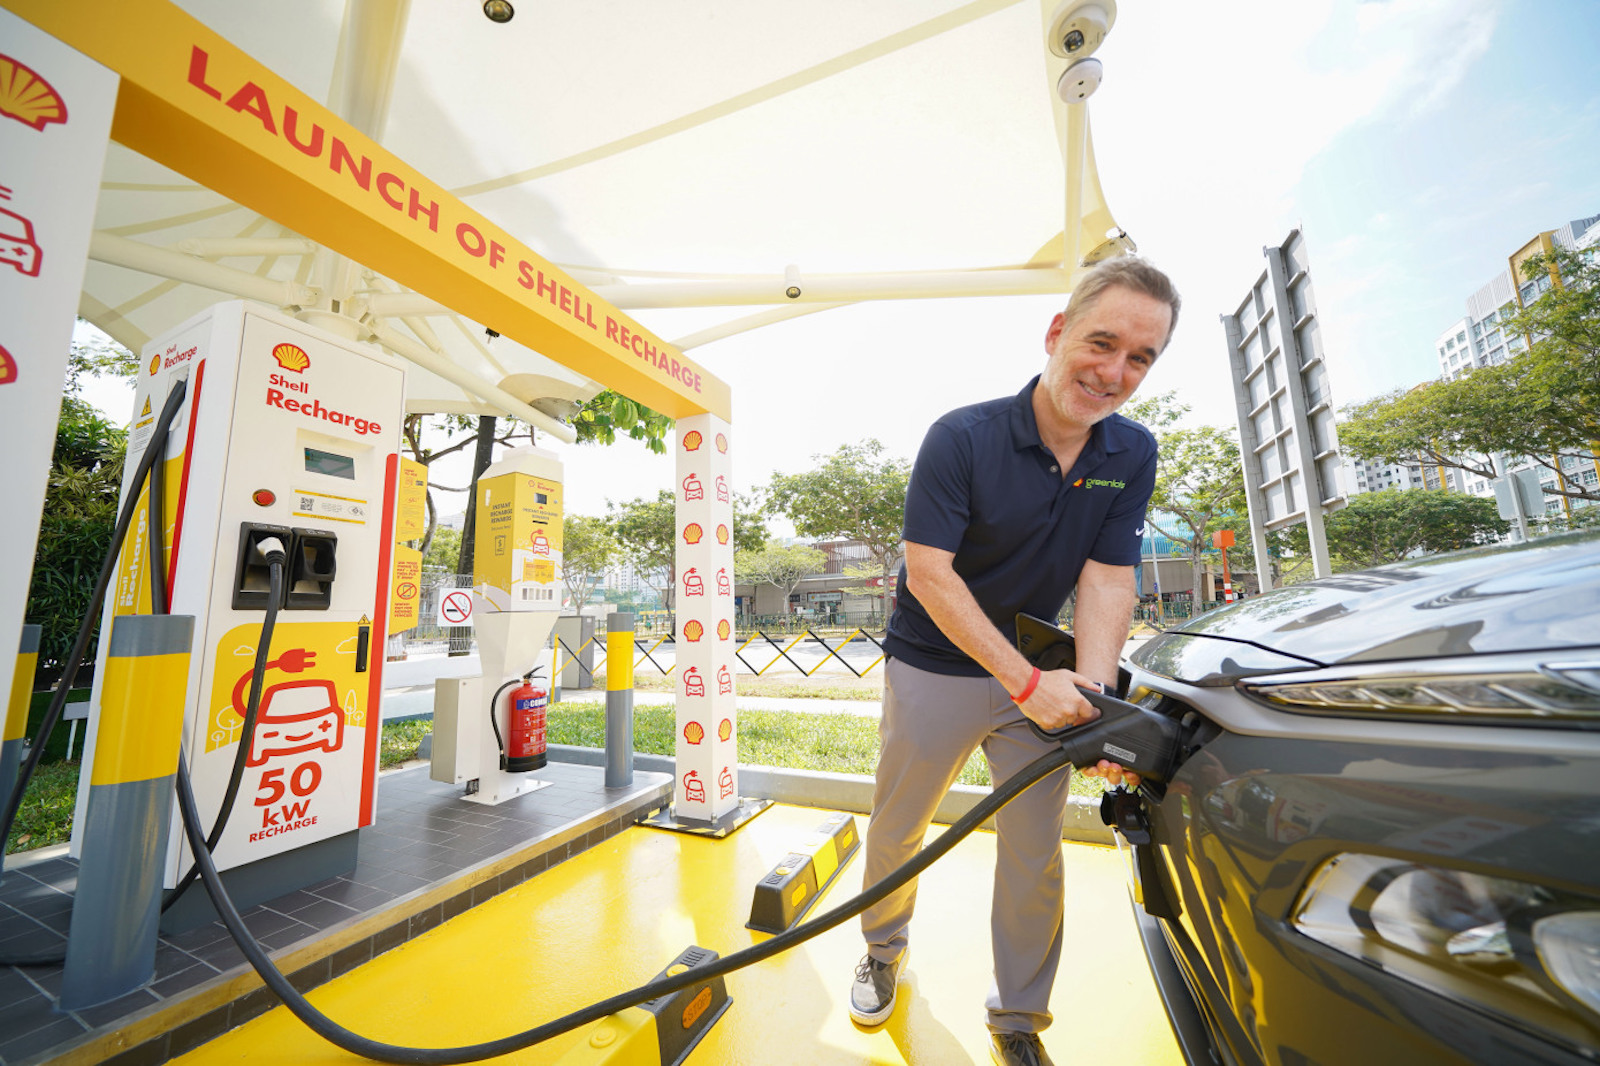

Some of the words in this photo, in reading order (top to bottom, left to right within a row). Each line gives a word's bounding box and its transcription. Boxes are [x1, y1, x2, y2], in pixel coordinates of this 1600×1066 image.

[187, 44, 440, 233] LAUNCH
[455, 222, 506, 269] OF
[517, 260, 598, 330] SHELL
[605, 315, 702, 395] RECHARGE
[164, 346, 198, 370] Recharge
[269, 373, 309, 395] Shell
[265, 387, 382, 436] Recharge
[125, 508, 146, 607] Recharge
[253, 760, 322, 807] 50
[249, 815, 318, 843] RECHARGE
[262, 798, 312, 829] kW
